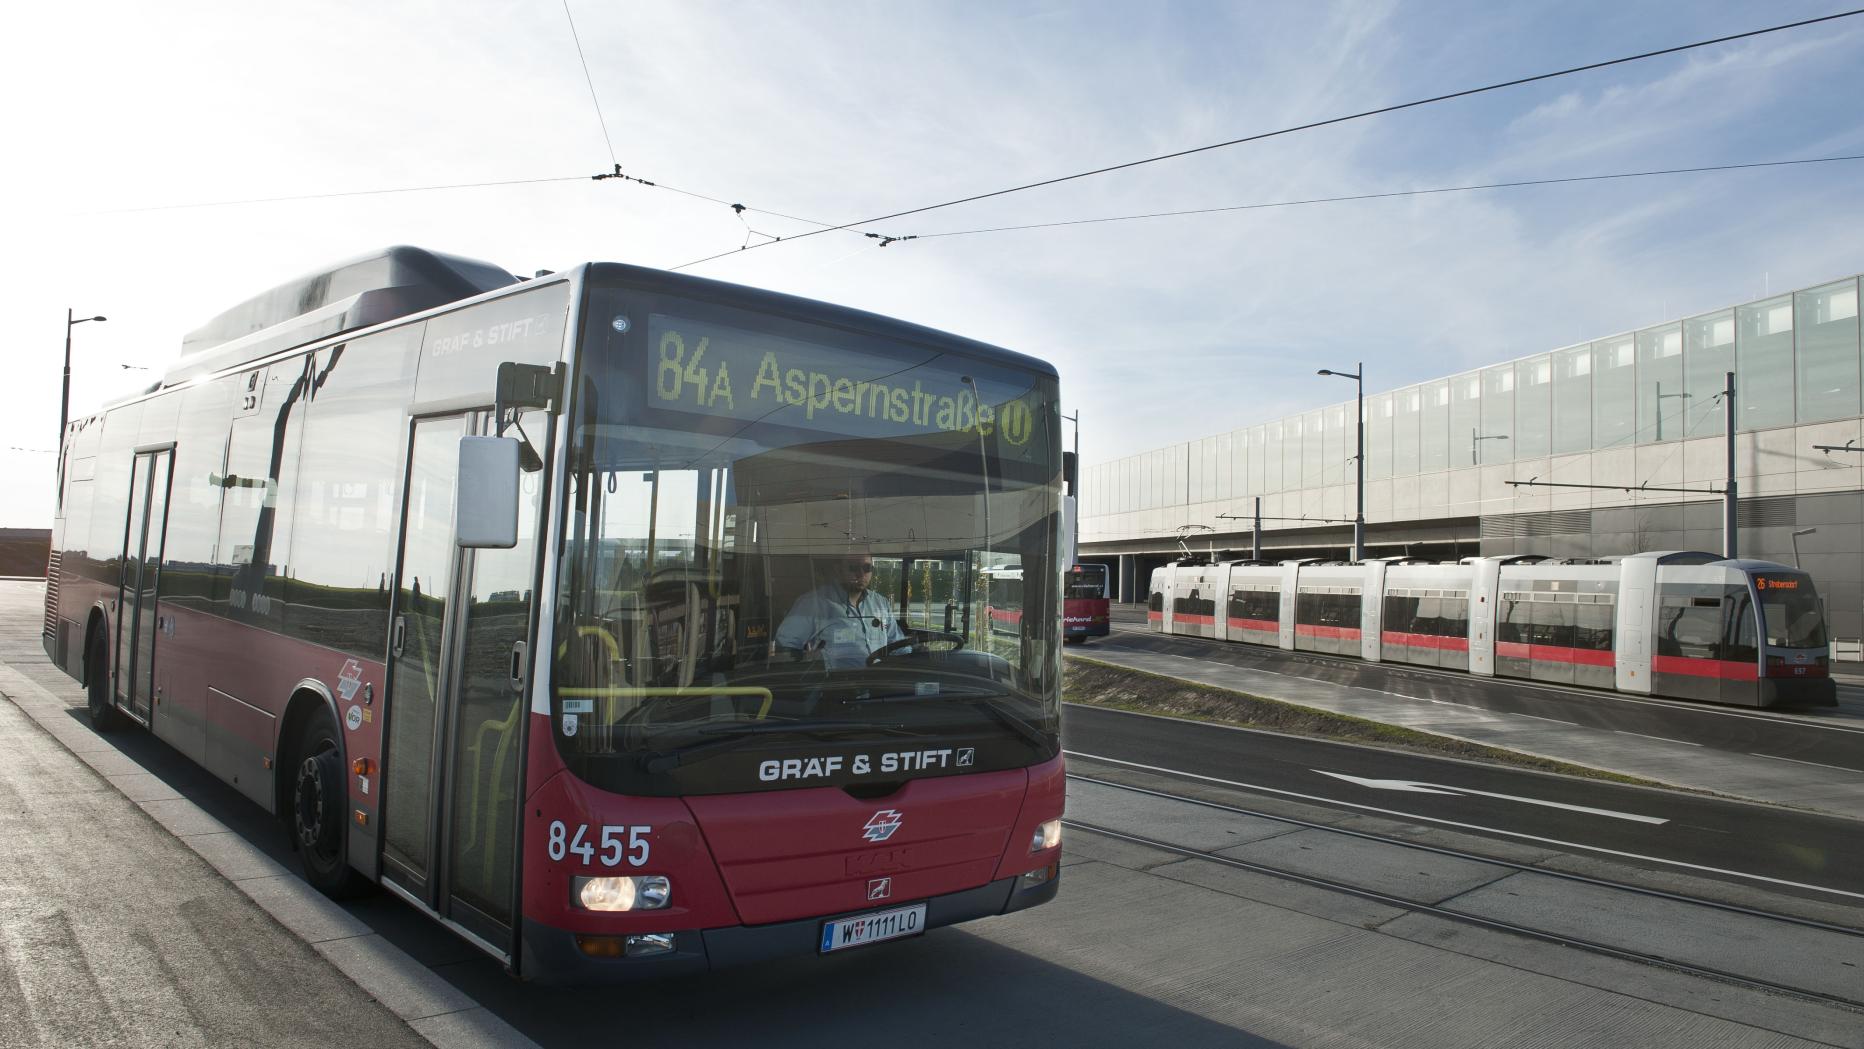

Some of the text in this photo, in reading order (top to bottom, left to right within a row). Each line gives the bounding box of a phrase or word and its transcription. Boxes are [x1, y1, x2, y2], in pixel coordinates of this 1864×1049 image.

[487, 318, 534, 344] STIFT
[657, 330, 734, 410] 84A
[750, 351, 996, 436] Aspernstraße
[1757, 577, 1766, 590] 26
[759, 750, 951, 781] GRÄF & STIFT
[548, 820, 650, 867] 8455
[842, 923, 854, 943] W
